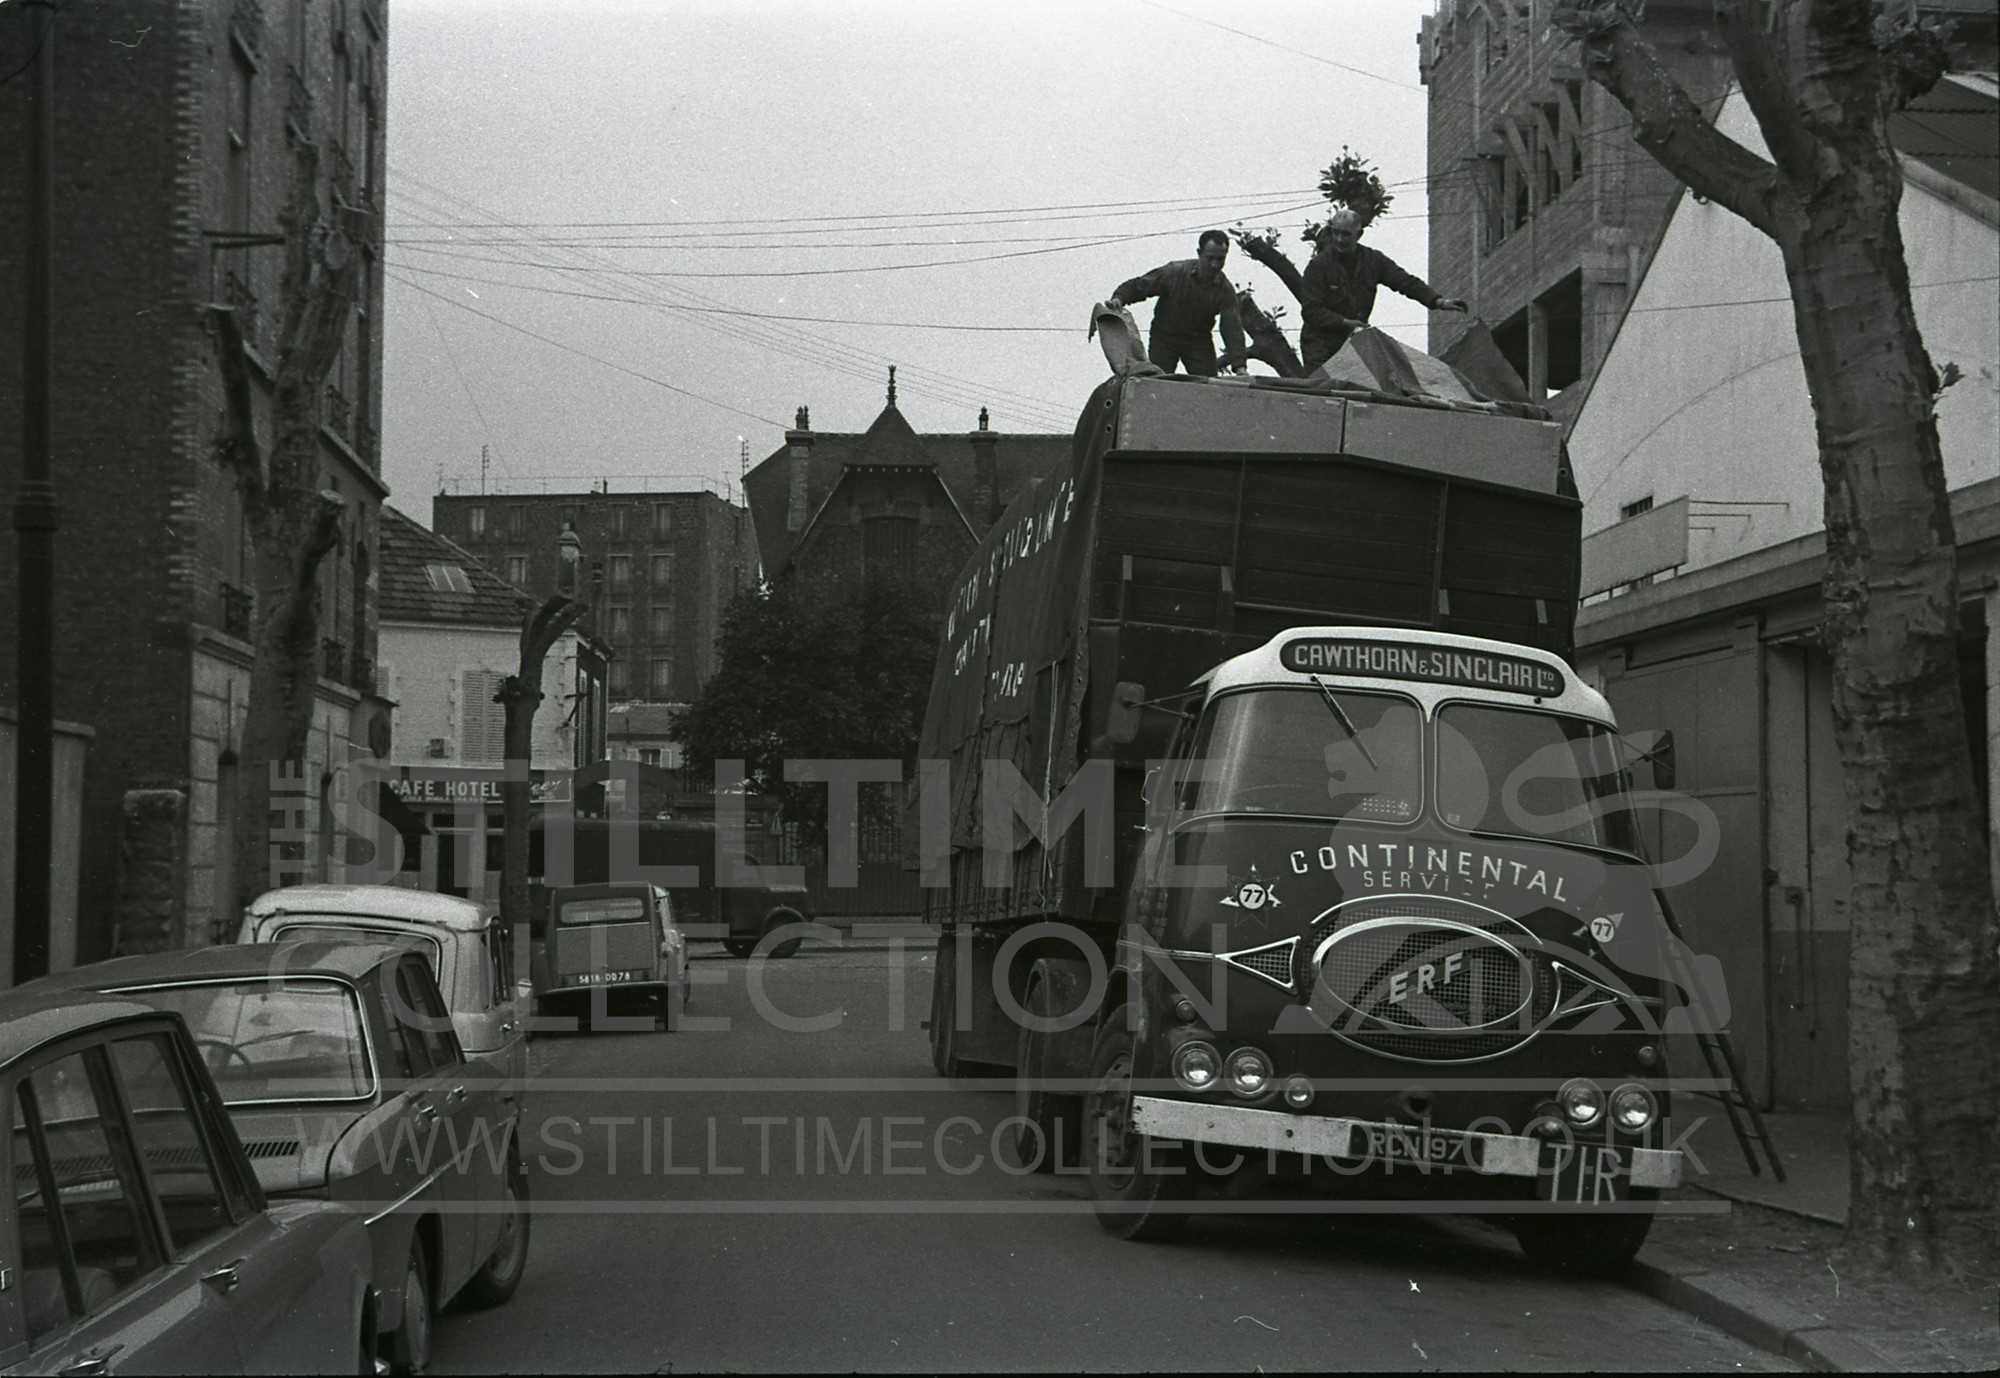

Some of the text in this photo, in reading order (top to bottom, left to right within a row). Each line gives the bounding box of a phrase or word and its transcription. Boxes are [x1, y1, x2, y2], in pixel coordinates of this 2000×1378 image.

[1294, 644, 1417, 674] CAWTHORN
[1431, 651, 1533, 690] SINCLAIR
[389, 779, 502, 797] CAFE HOTEL
[1243, 889, 1264, 904] 77
[1290, 843, 1568, 904] CONTINENTAL
[1593, 922, 1612, 938] 77
[1388, 951, 1465, 1005] ERF
[1546, 1142, 1623, 1206] TIR
